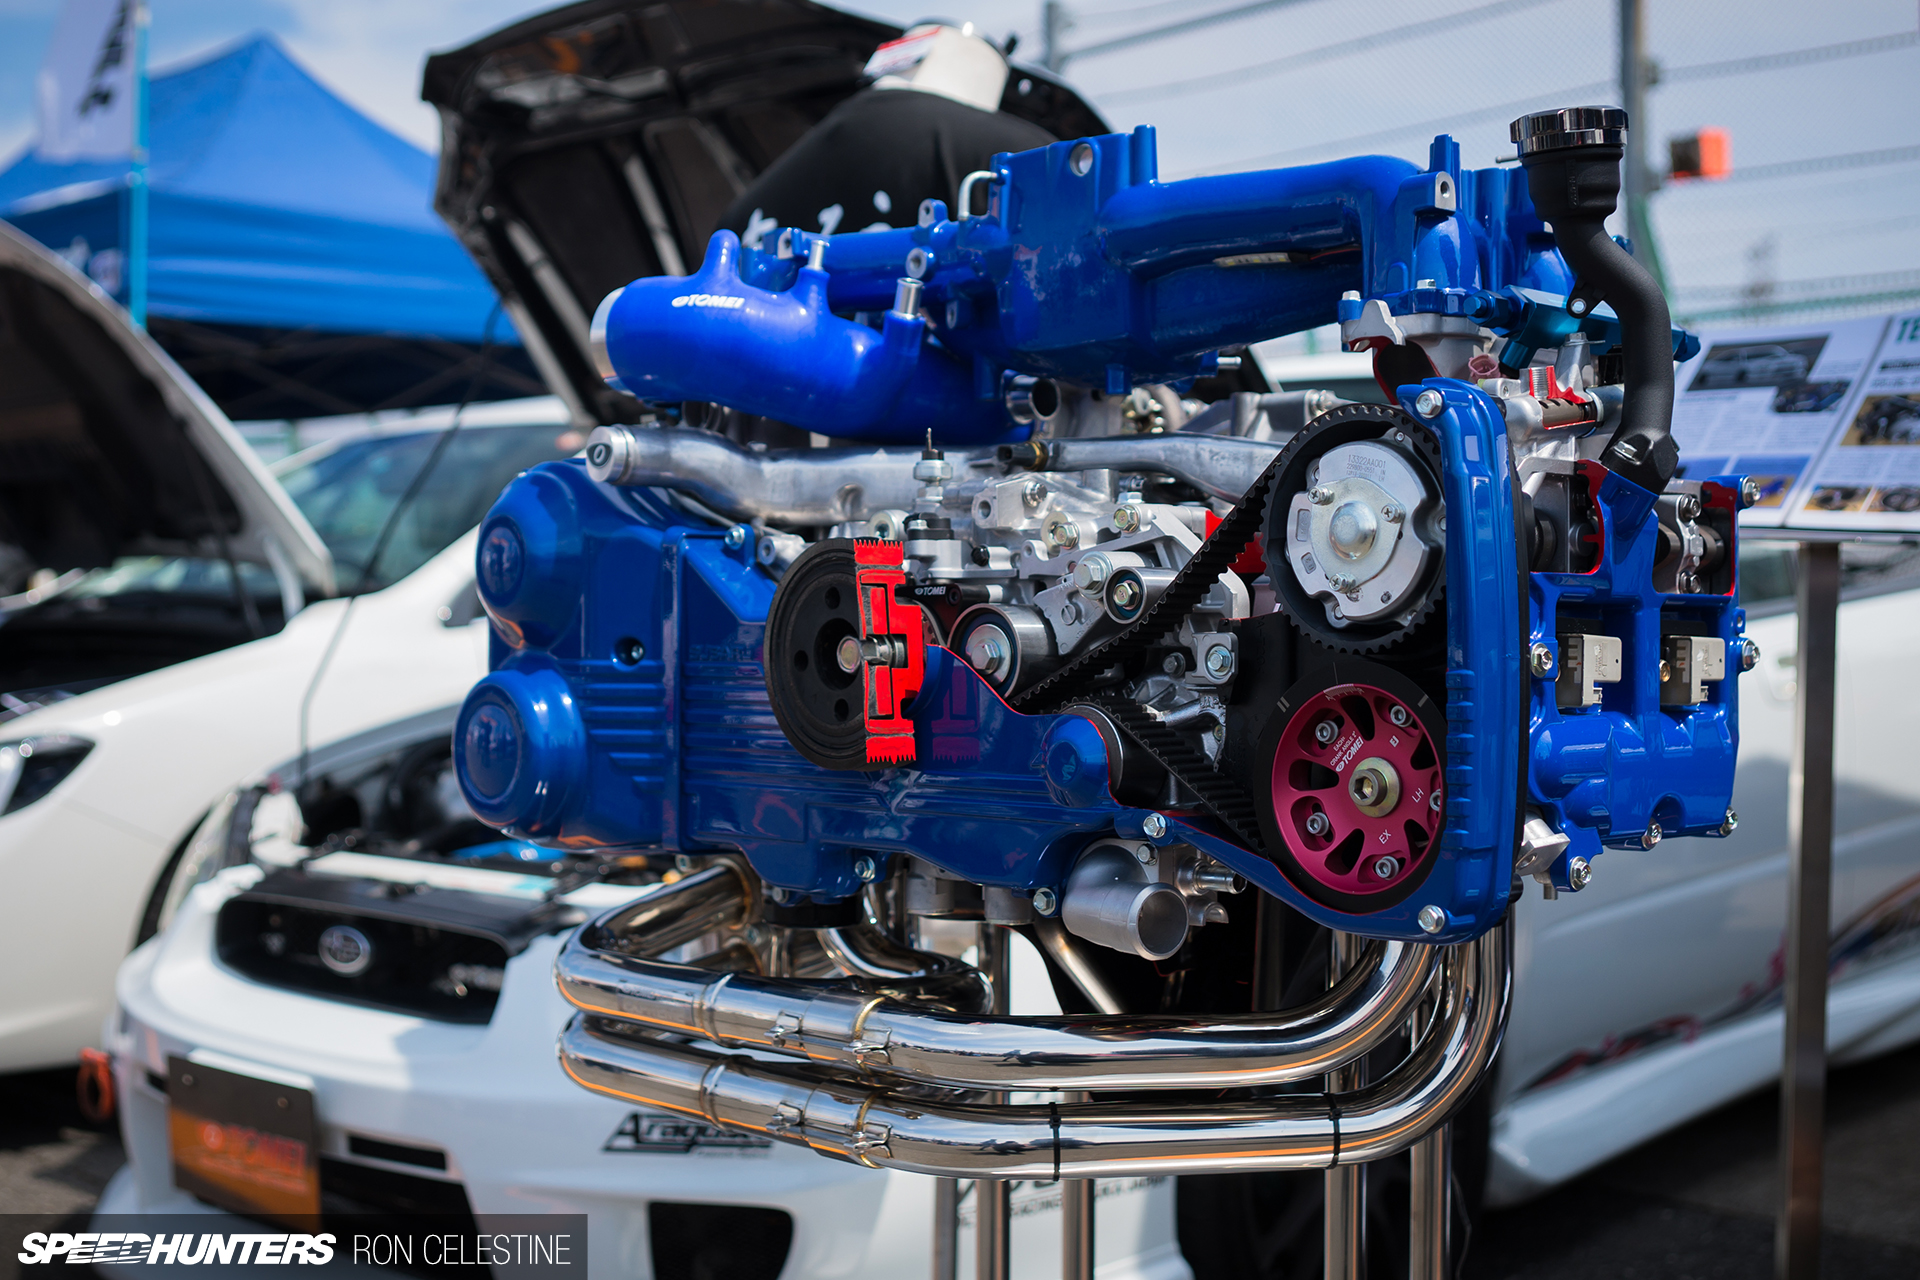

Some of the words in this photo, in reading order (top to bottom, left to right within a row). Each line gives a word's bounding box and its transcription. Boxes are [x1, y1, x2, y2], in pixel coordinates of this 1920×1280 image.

[686, 293, 745, 309] TOMEI
[922, 585, 947, 596] TOMEI
[1342, 736, 1364, 765] TOMEI
[1412, 787, 1425, 803] LH
[1378, 829, 1392, 844] EX
